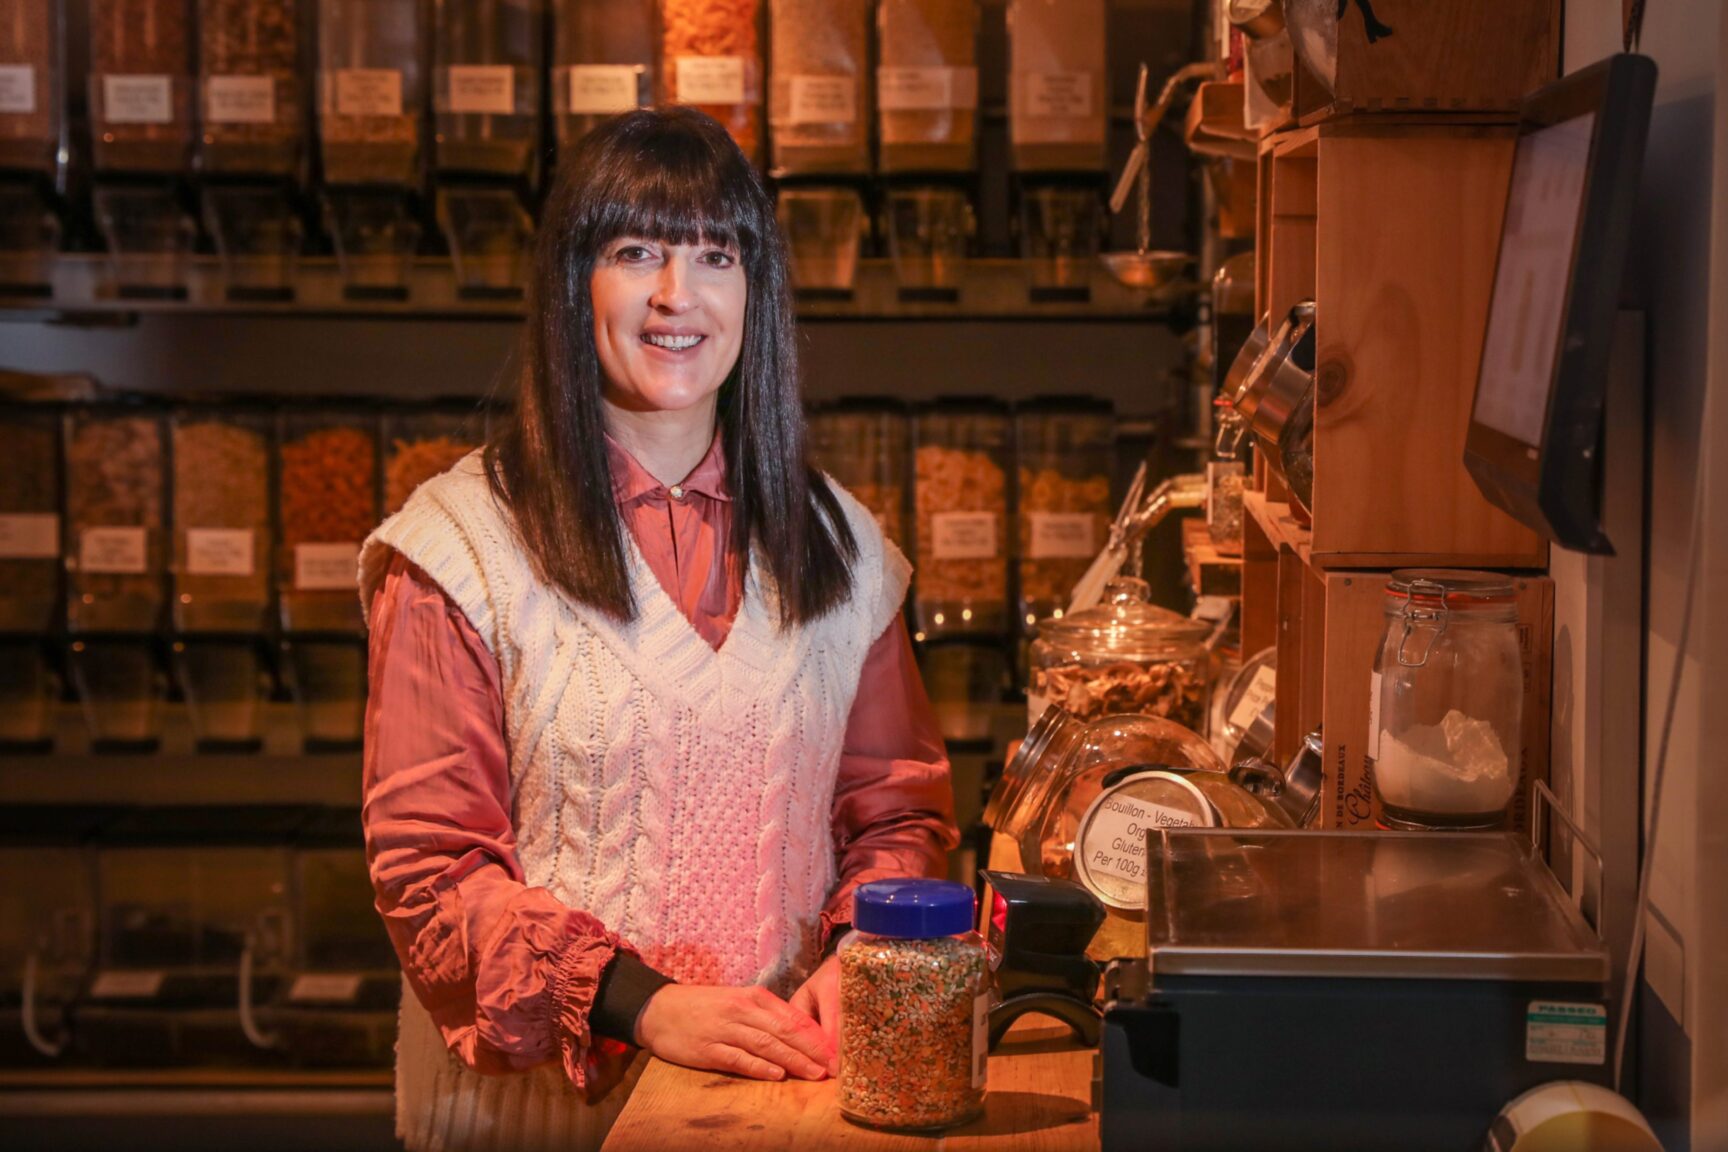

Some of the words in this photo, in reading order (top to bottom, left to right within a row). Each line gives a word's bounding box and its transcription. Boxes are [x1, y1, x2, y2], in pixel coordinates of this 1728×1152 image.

[1337, 745, 1346, 801] BORDEAUX
[1105, 799, 1145, 819] Bouillon
[1127, 822, 1146, 842] Org
[1093, 850, 1113, 867] Per
[1115, 857, 1140, 878] 100g
